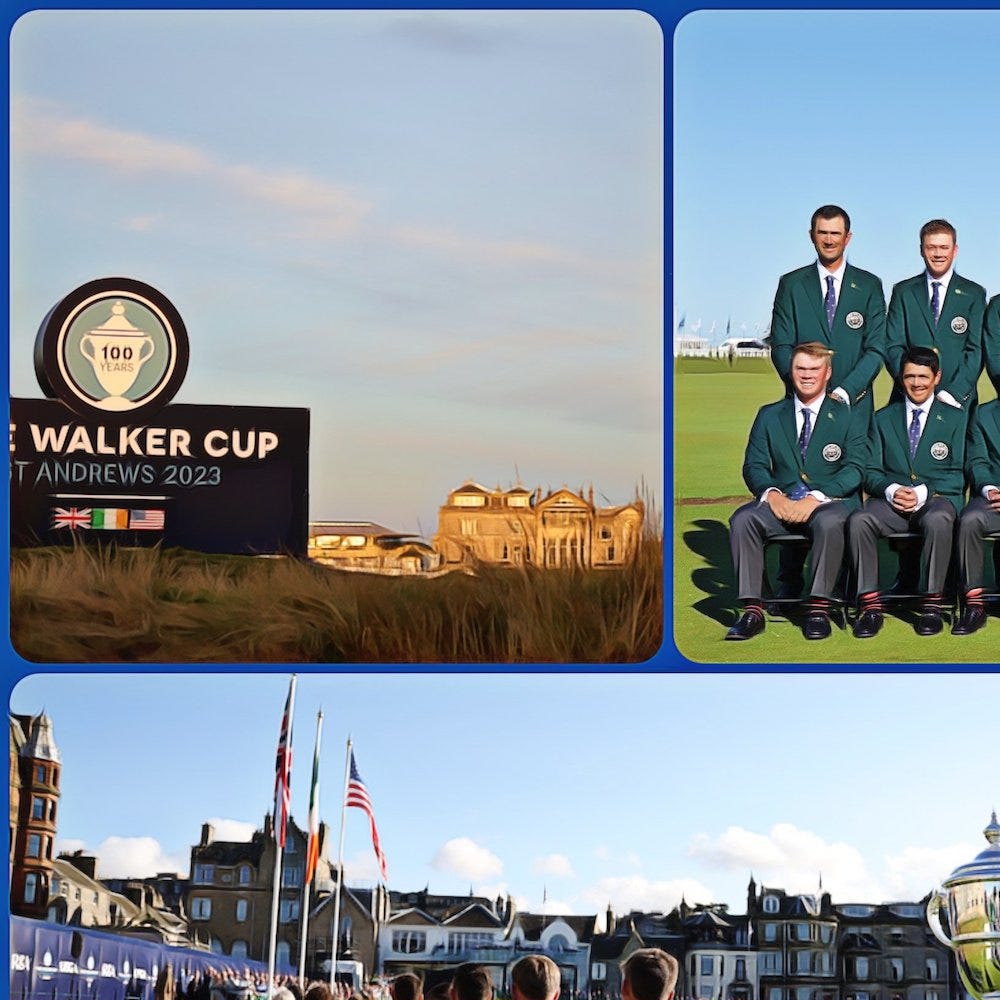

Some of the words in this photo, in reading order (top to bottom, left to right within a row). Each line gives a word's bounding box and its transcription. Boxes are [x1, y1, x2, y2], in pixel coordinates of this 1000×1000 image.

[102, 346, 133, 360] 100
[101, 362, 134, 372] YEARS
[30, 423, 193, 457] WALKER
[203, 429, 279, 459] CUP
[35, 460, 155, 487] ANDREWS
[163, 464, 221, 486] 2023
